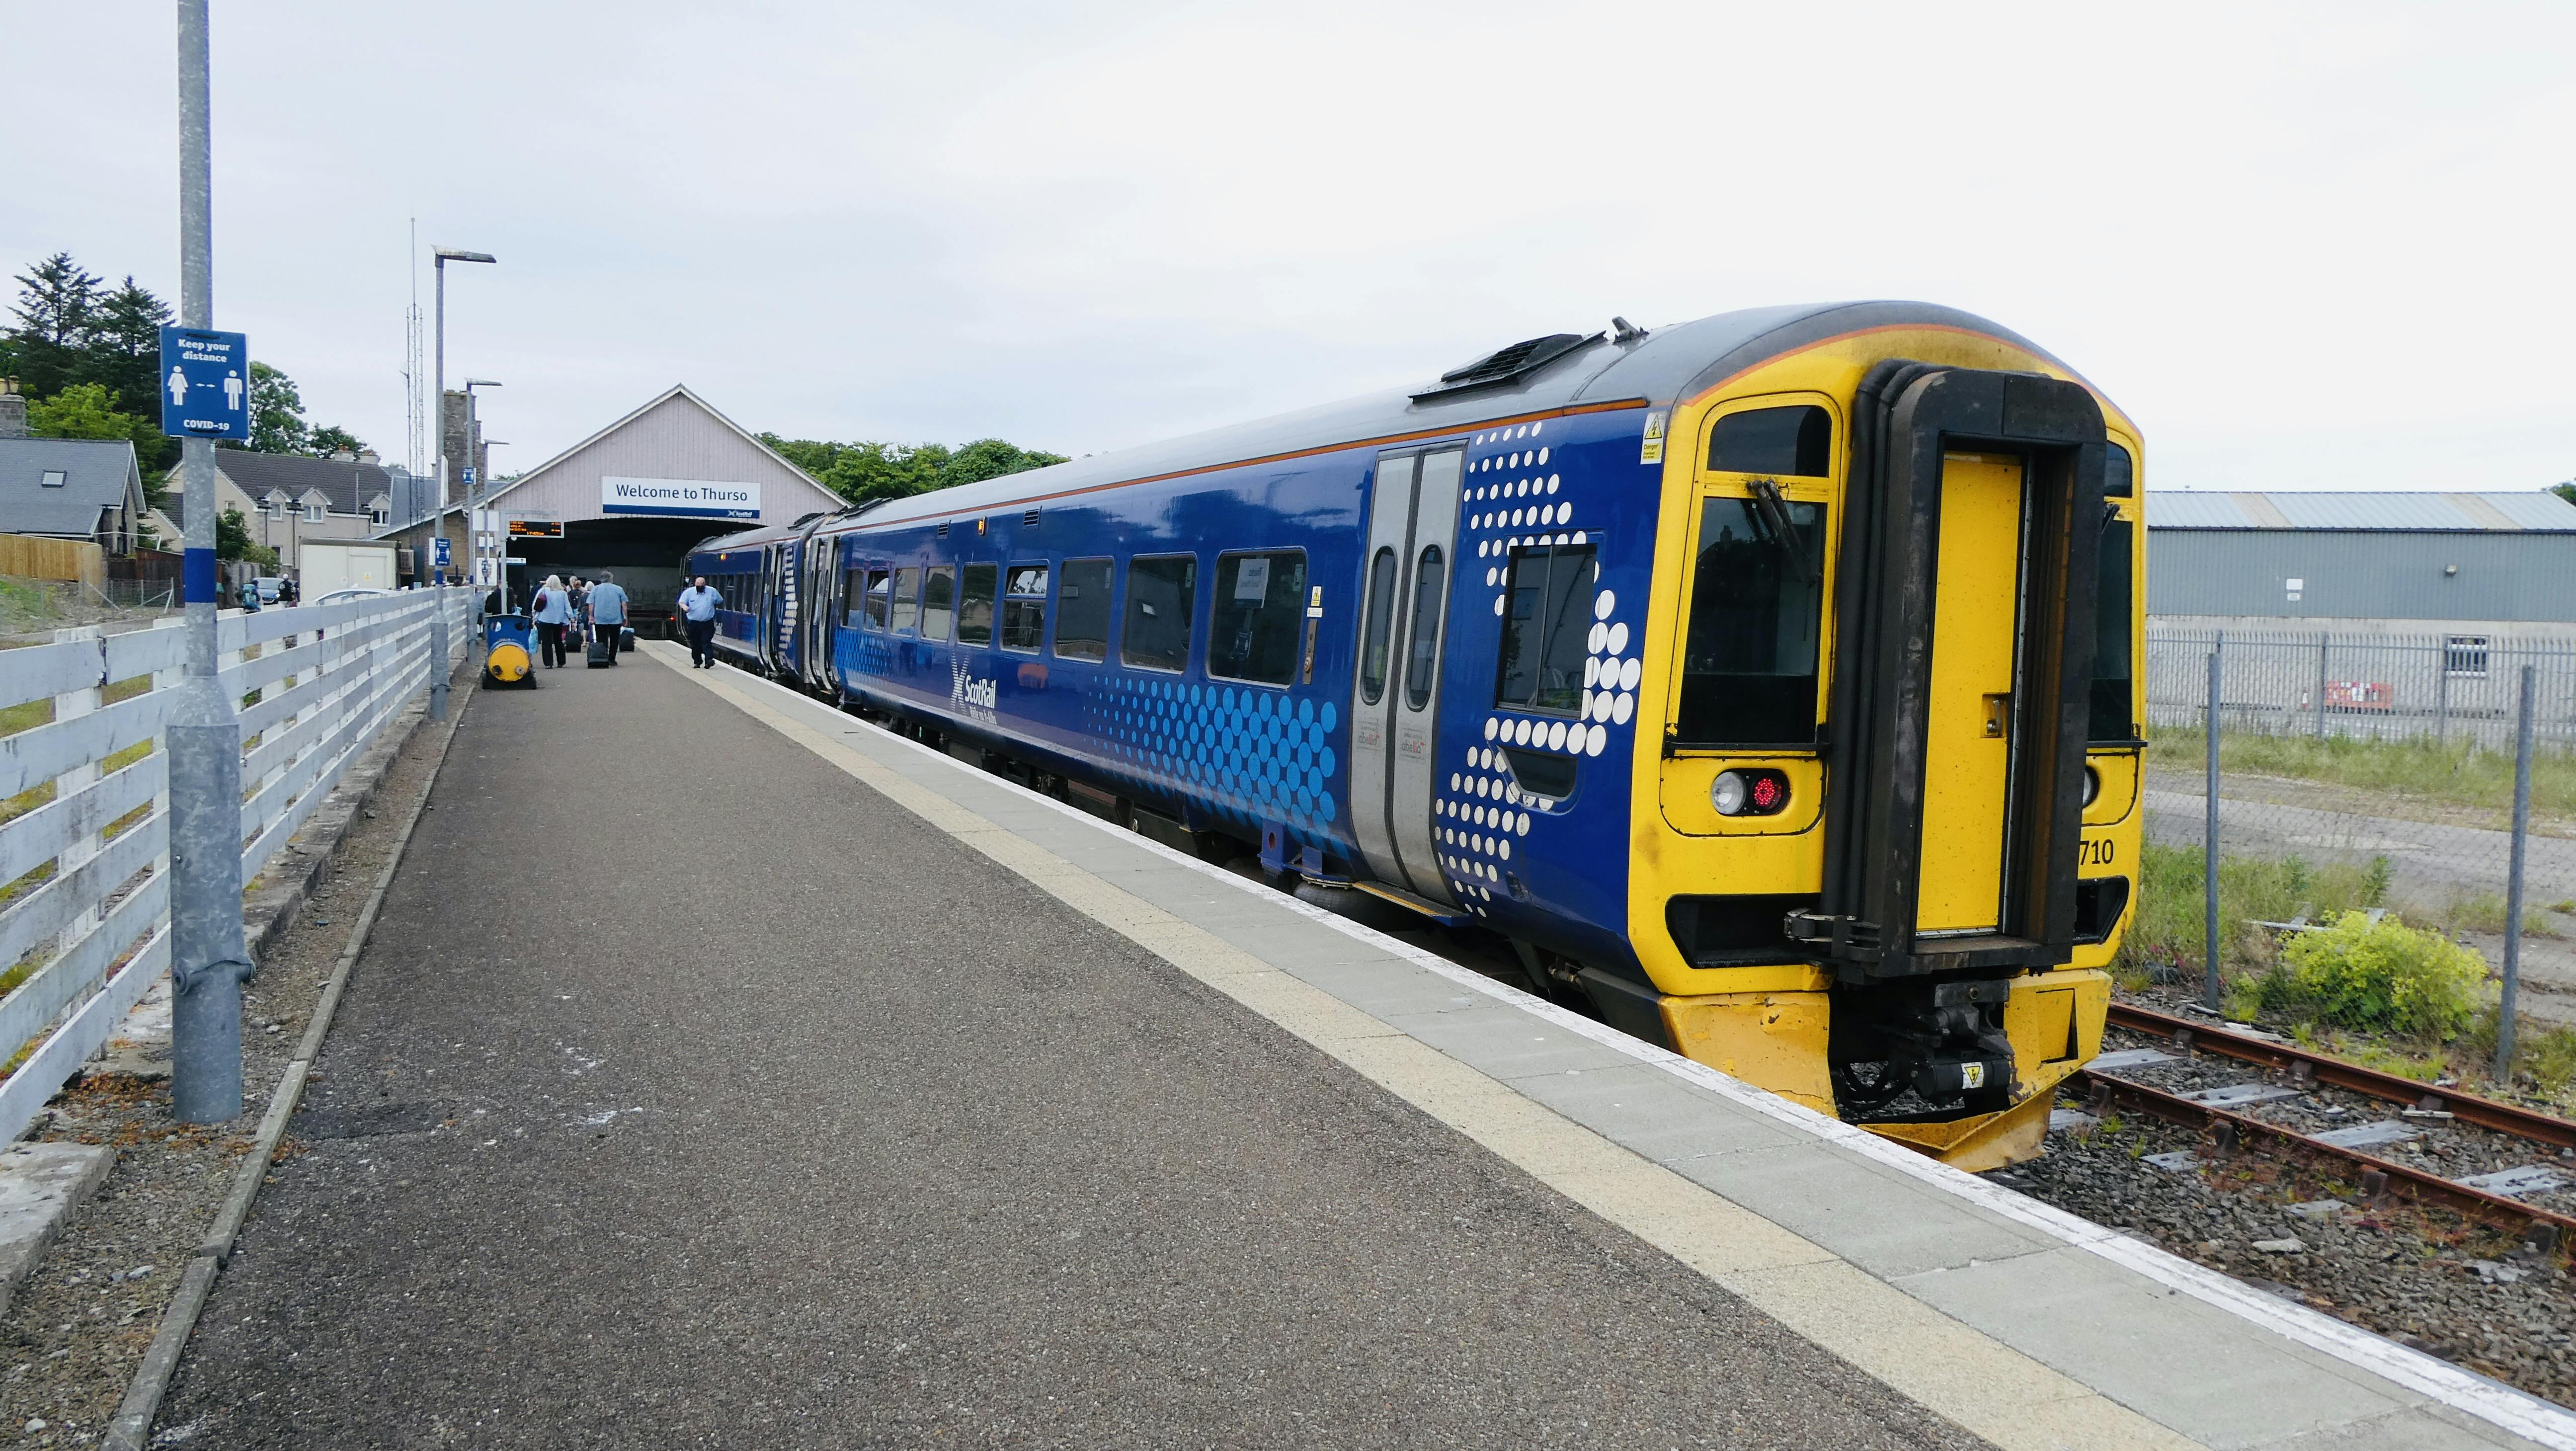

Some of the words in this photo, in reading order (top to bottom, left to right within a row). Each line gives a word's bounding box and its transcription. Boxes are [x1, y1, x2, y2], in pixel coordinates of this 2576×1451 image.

[178, 339, 204, 350] Keep
[207, 342, 231, 351] your
[182, 351, 227, 362] distance
[183, 419, 230, 430] COVID-19
[616, 484, 679, 498] Welcome
[684, 488, 697, 499] to
[701, 487, 747, 501] Thurso
[965, 675, 996, 709] ScotRail
[2080, 839, 2113, 865] 710
